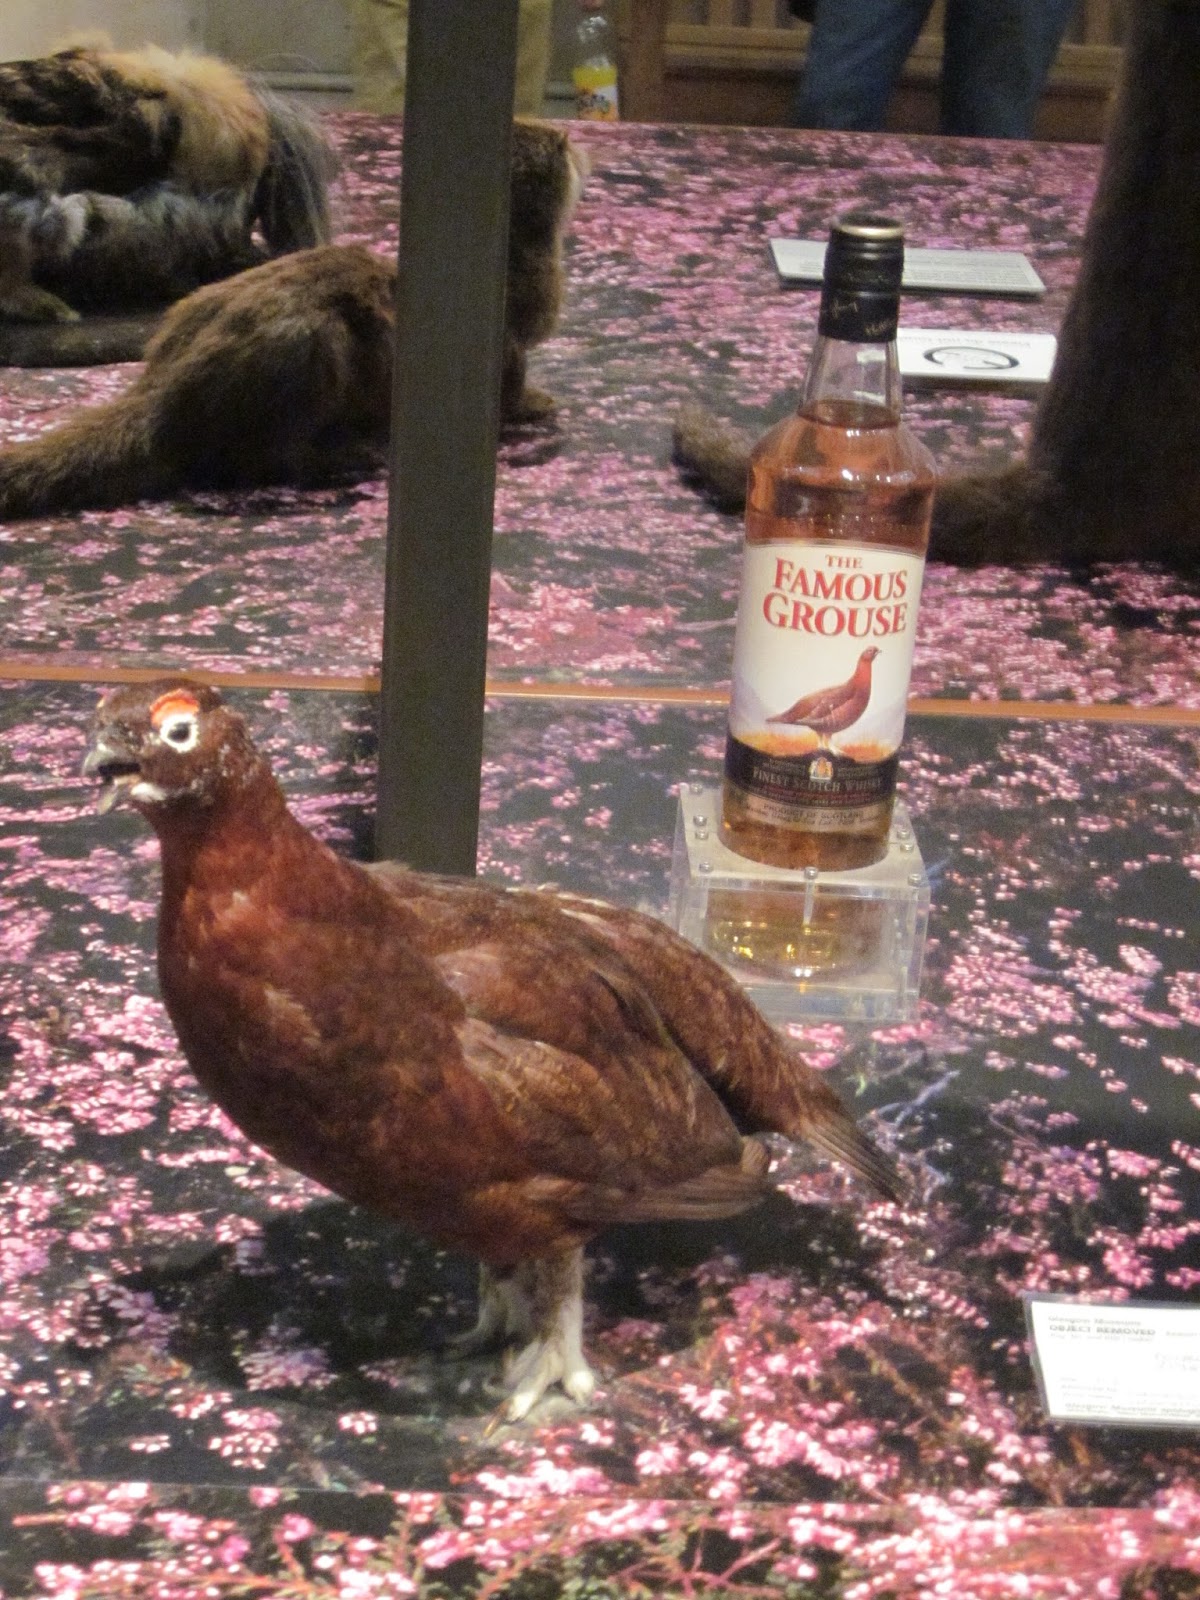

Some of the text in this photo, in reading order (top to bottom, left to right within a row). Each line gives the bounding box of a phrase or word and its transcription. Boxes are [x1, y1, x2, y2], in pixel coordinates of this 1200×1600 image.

[825, 555, 863, 568] THE
[774, 557, 907, 601] FAMOUS
[763, 592, 908, 637] GROUSE
[753, 766, 790, 786] FINEST
[793, 777, 840, 792] SCOTCH
[1049, 1324, 1091, 1333] OBJECT
[1096, 1327, 1156, 1336] REMOVED
